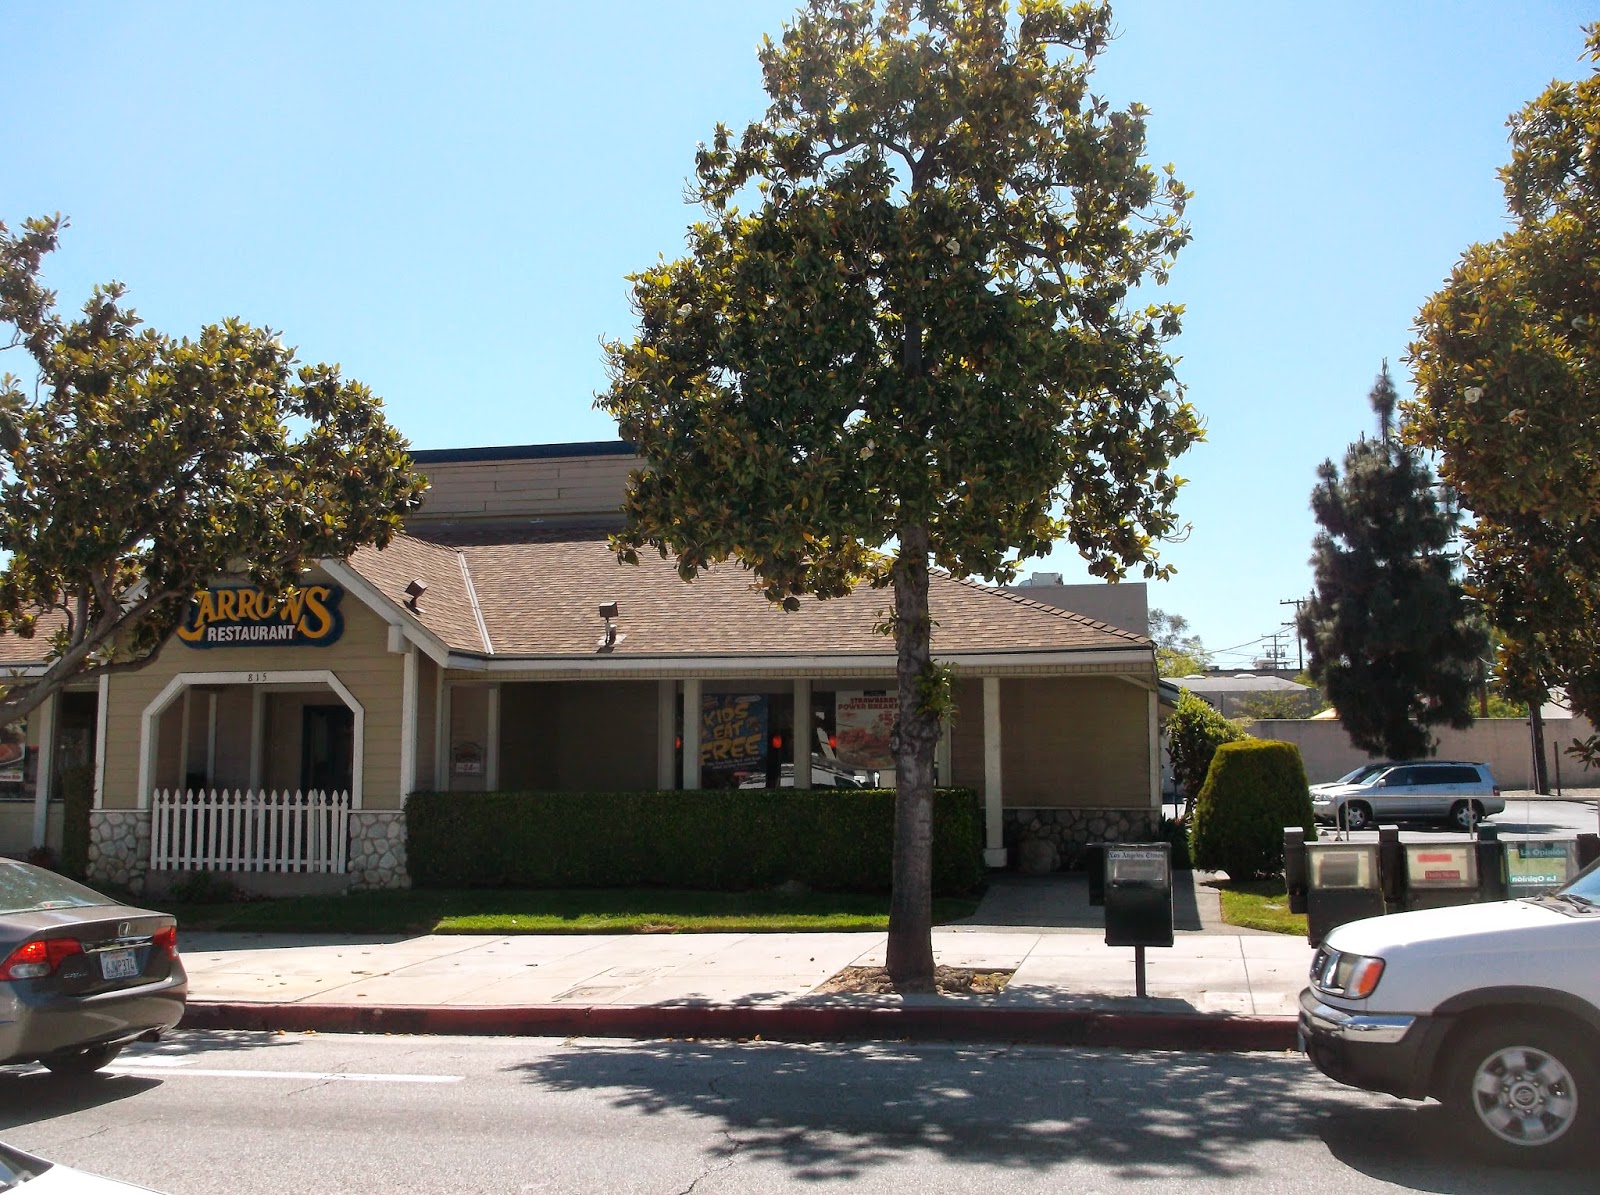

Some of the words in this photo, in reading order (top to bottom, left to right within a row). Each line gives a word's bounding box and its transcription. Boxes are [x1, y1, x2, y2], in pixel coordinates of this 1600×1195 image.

[207, 625, 295, 641] RESTAURANT
[247, 672, 267, 682] 815
[838, 703, 866, 711] POWER
[850, 696, 898, 704] STRAWBERRY
[704, 703, 749, 726] KIDS
[713, 719, 744, 740] EAT
[699, 733, 762, 767] FREE
